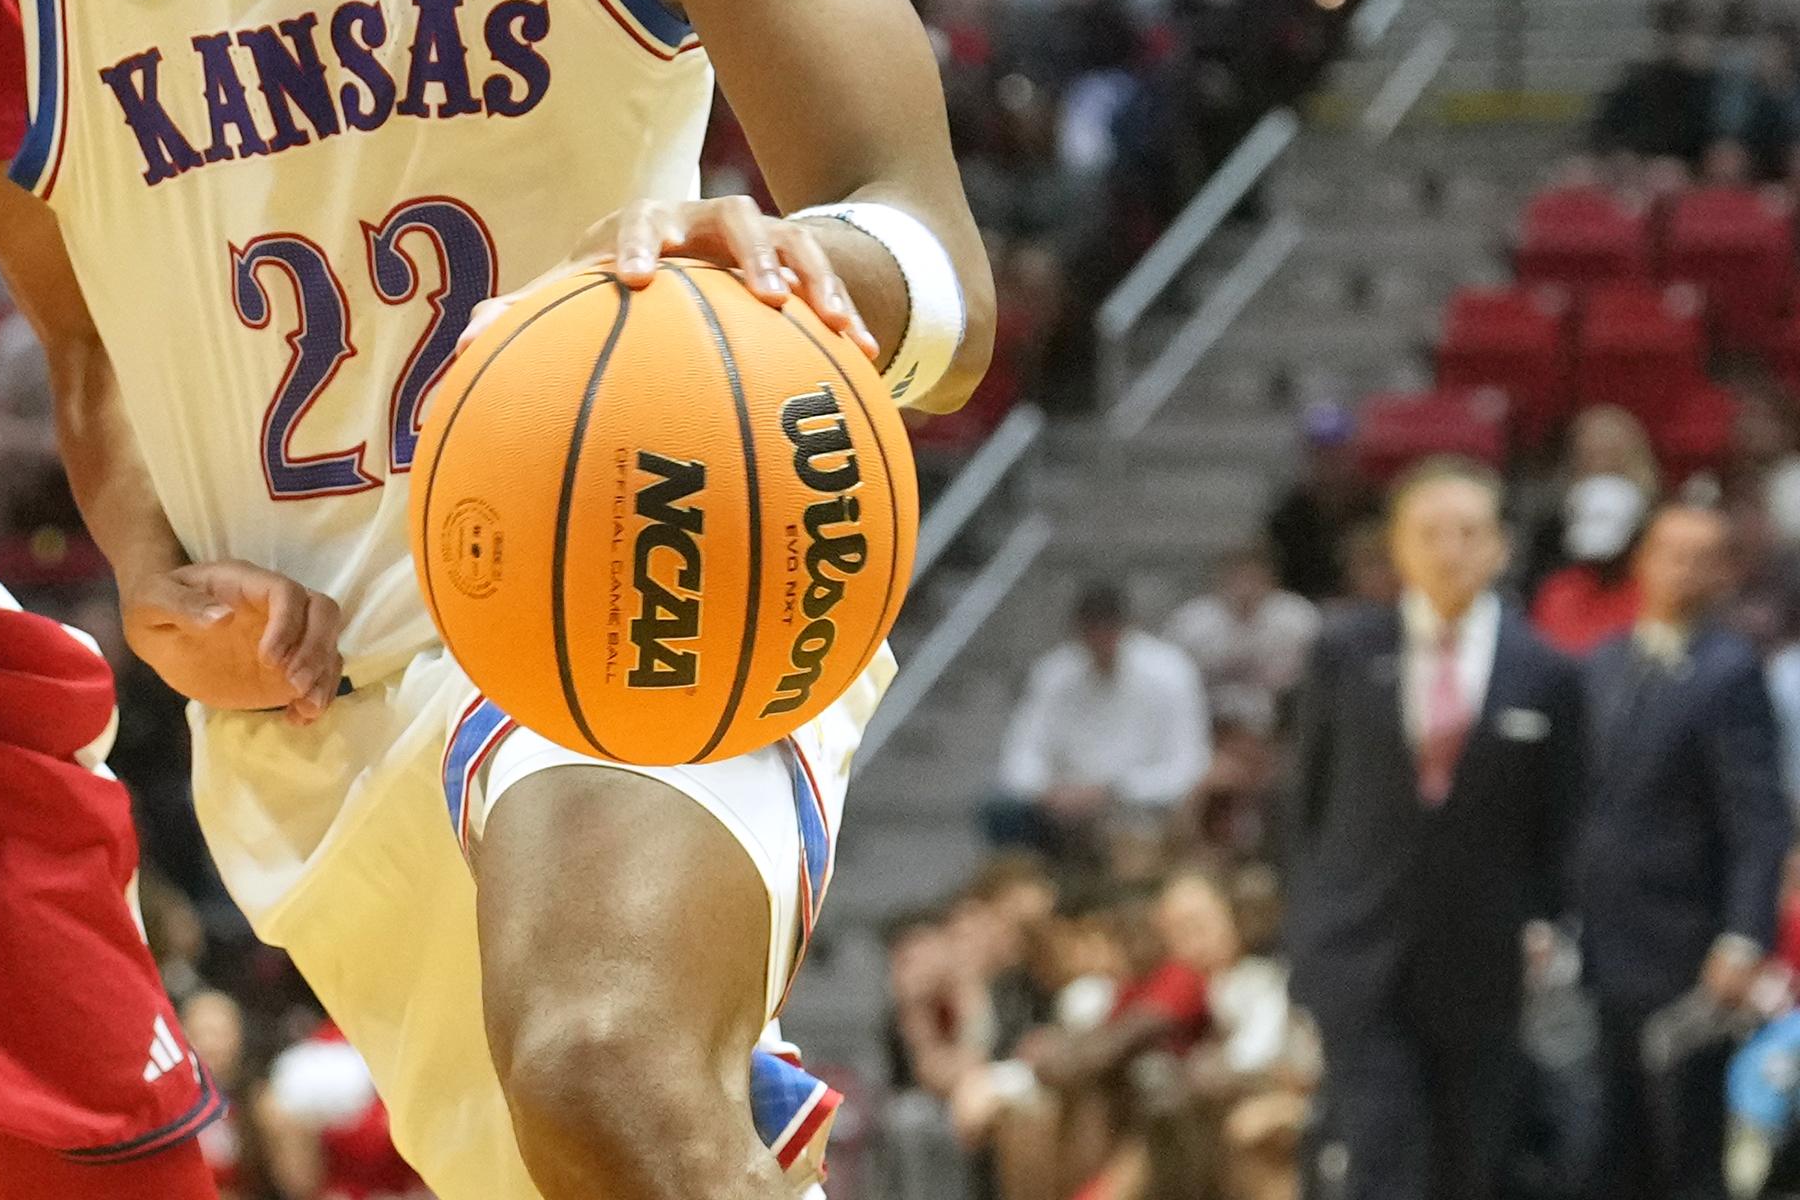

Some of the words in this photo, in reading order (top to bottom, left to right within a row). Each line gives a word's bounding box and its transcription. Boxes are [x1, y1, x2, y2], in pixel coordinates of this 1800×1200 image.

[228, 195, 498, 501] 22
[627, 449, 707, 689] NCAA
[757, 381, 868, 718] Wilson
[785, 524, 798, 573] EVO
[608, 559, 622, 626] GAME
[782, 580, 796, 626] NXT
[606, 631, 620, 684] BALL
